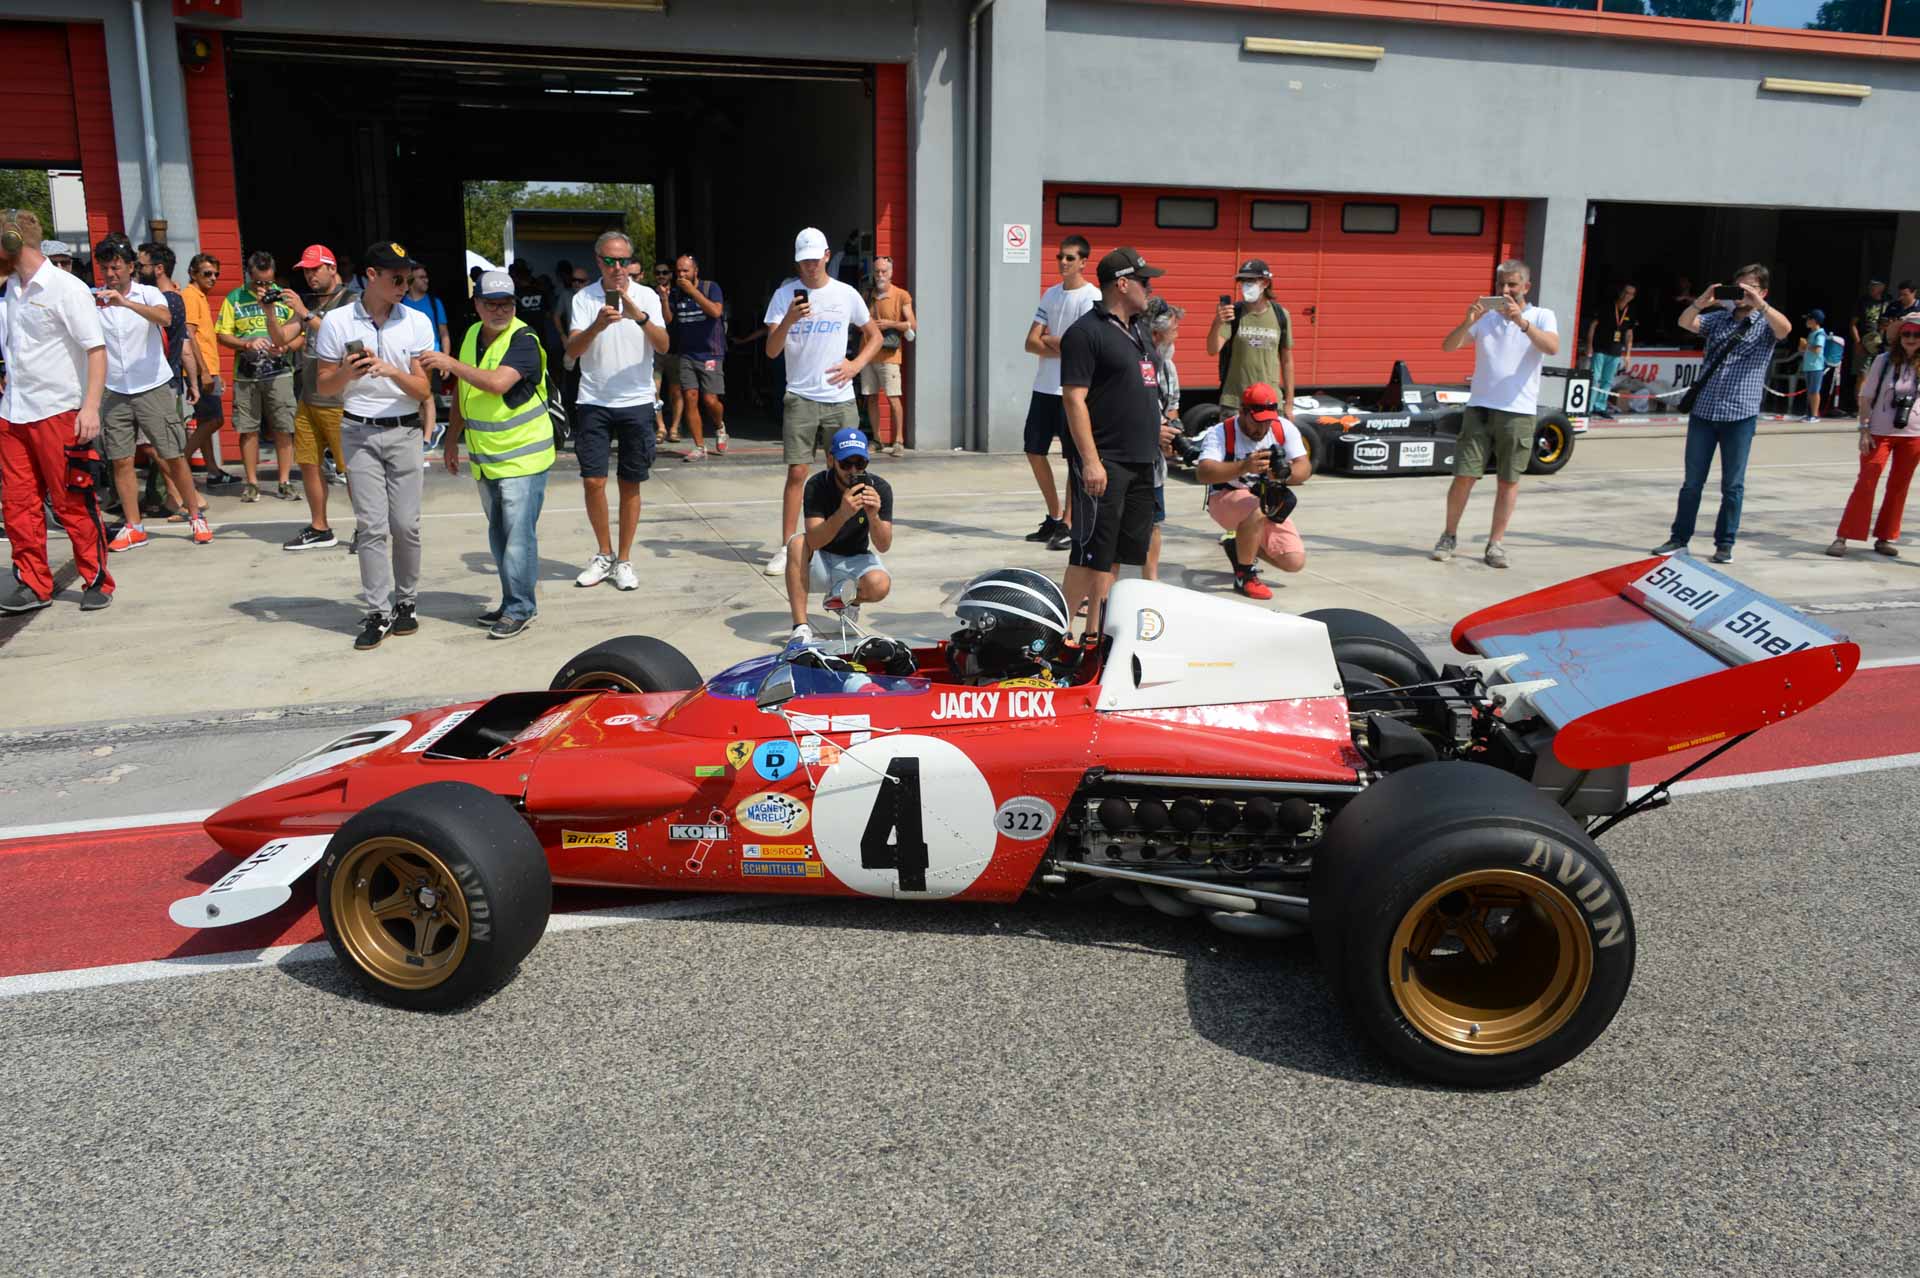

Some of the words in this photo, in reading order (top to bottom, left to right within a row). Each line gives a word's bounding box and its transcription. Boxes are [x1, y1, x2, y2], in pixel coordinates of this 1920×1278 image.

[1570, 384, 1584, 408] 8
[1366, 416, 1411, 430] reynard
[1357, 446, 1385, 457] IMO
[1645, 566, 1720, 611] Shell
[1724, 611, 1812, 656] Shel
[931, 691, 1000, 719] JACKY
[1008, 690, 1057, 718] ICKX
[765, 754, 785, 768] D
[771, 768, 780, 778] 4
[747, 803, 787, 815] MAGNETI
[747, 810, 787, 823] MARELLI
[860, 756, 929, 891] 4
[1004, 811, 1043, 831] 322
[567, 834, 612, 844] Britax
[671, 825, 727, 839] KONI
[743, 863, 805, 874] SCHMITTHELM
[1521, 838, 1626, 949] AVON
[453, 863, 491, 942] AVON
